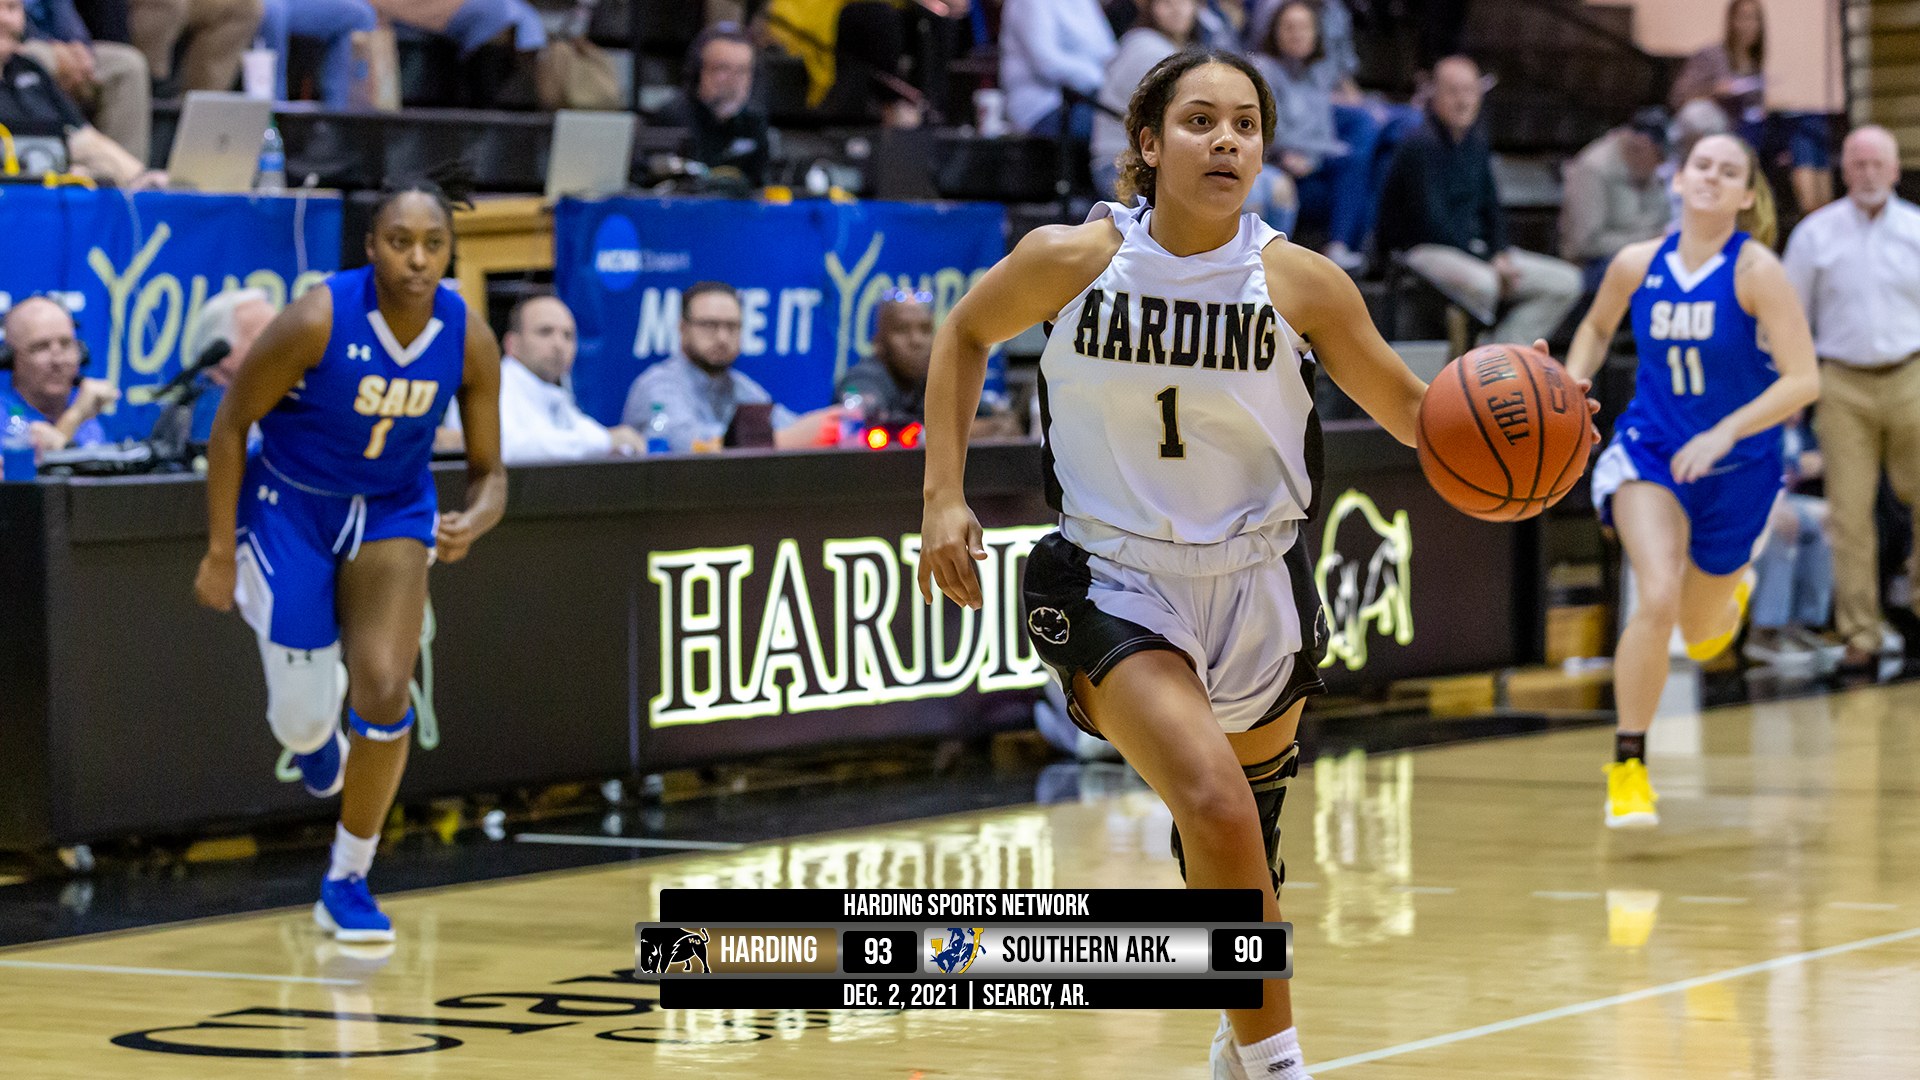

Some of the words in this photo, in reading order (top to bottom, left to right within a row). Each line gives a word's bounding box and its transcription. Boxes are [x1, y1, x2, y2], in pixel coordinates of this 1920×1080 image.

[633, 287, 770, 359] ME
[1650, 300, 1716, 341] SAU
[353, 374, 439, 417] SAU
[1667, 345, 1705, 396] 11
[363, 417, 394, 459] 1
[1155, 385, 1186, 460] 1
[1486, 390, 1530, 446] THE
[648, 524, 1056, 728] HARDI
